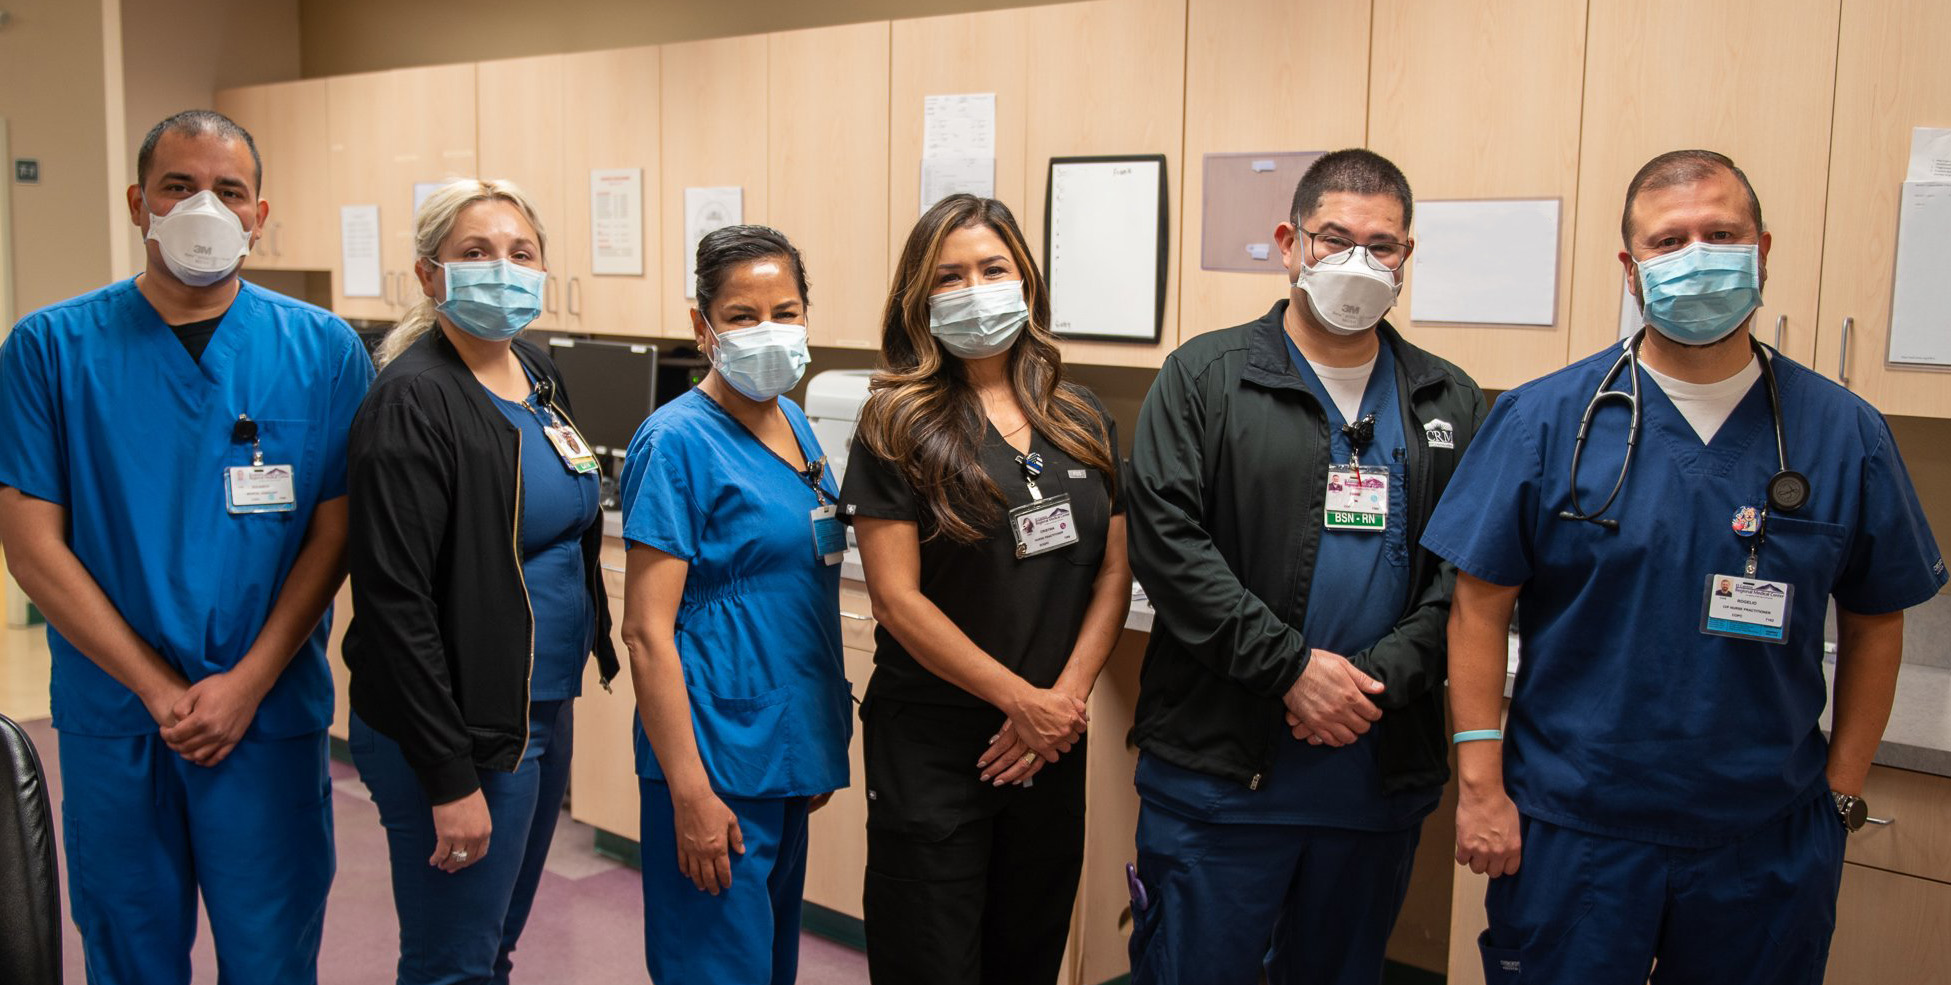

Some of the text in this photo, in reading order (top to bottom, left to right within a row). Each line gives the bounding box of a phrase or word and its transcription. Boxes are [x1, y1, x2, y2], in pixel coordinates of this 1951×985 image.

[193, 245, 212, 256] 3M
[1341, 304, 1360, 314] 3M
[1426, 430, 1453, 443] CRM
[1335, 512, 1355, 523] BSN
[1362, 513, 1376, 524] RN
